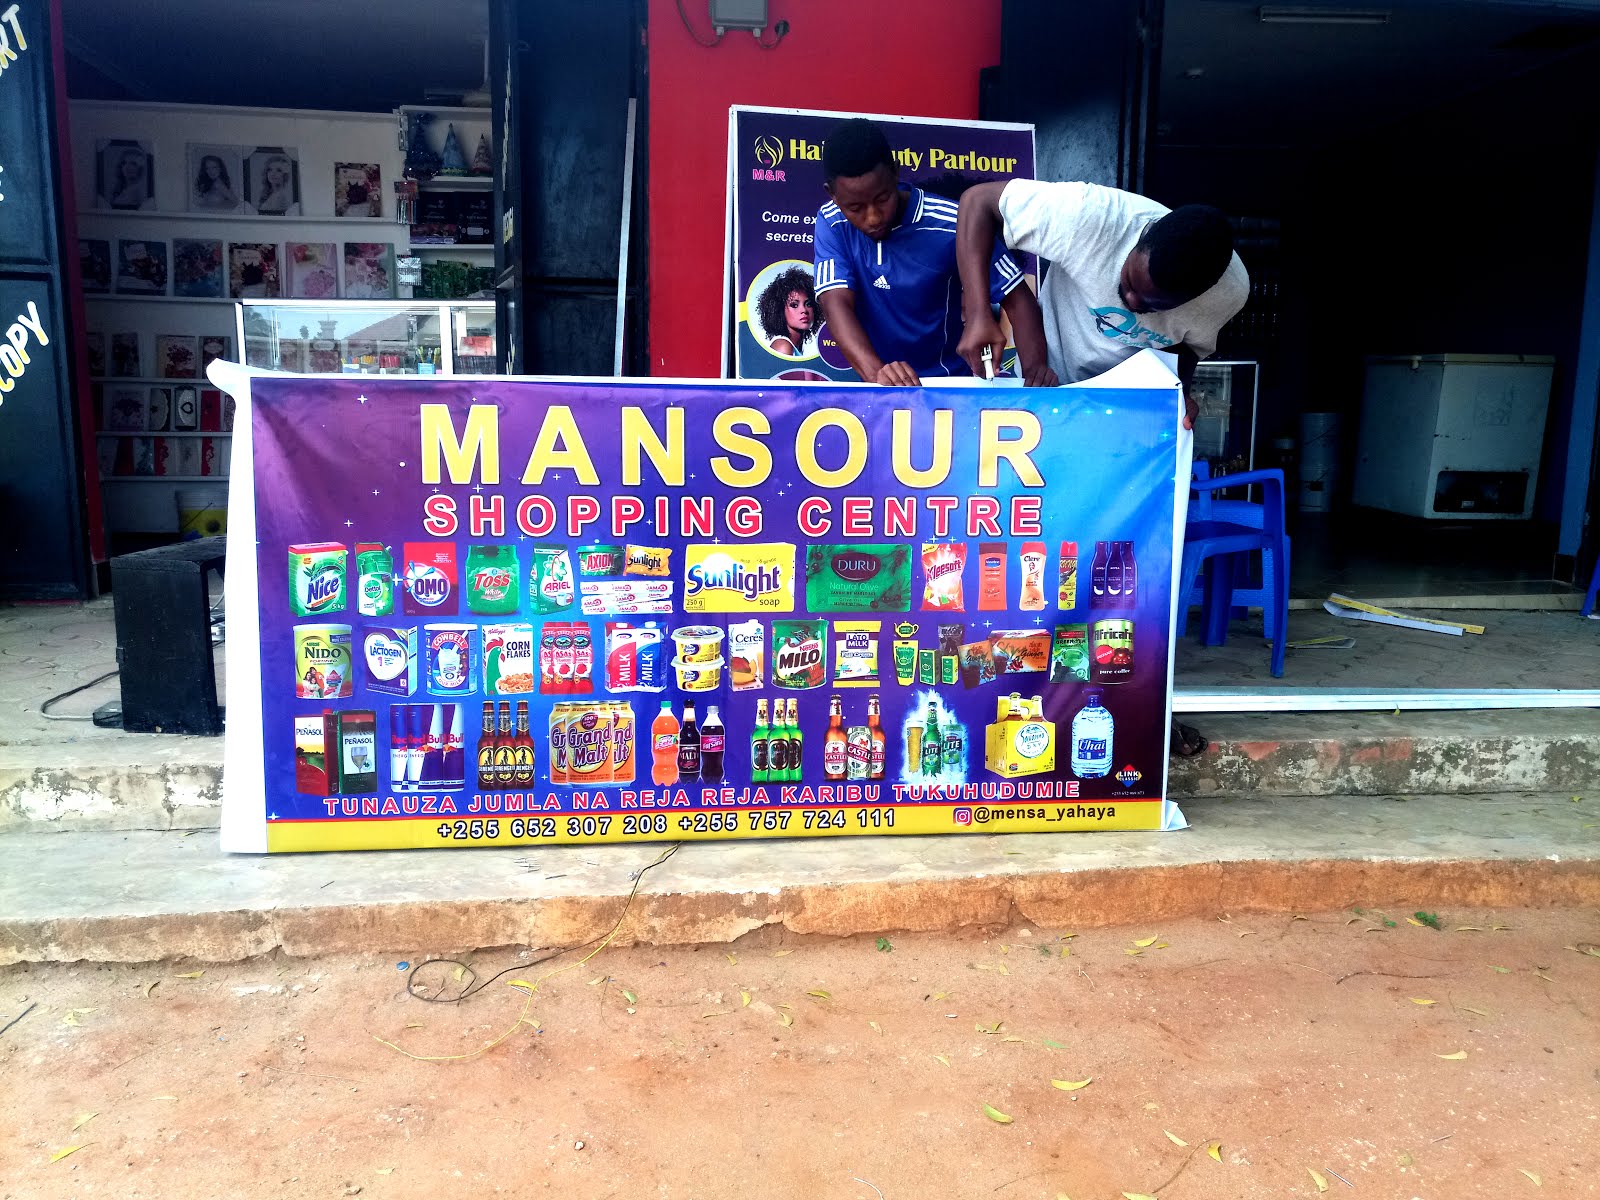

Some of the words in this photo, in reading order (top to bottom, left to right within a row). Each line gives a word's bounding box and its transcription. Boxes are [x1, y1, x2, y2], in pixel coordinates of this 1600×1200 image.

[929, 148, 1018, 173] Parlour
[753, 169, 786, 183] M&R
[761, 210, 799, 224] Come
[803, 215, 817, 225] ex
[765, 230, 814, 244] secrets
[420, 403, 1046, 488] MANSOUR
[423, 495, 763, 537] SHOPPING
[797, 496, 1042, 537] CENTRE
[627, 552, 661, 571] Sunlight
[838, 559, 877, 571] DURU
[926, 559, 962, 582] Kleesoft
[414, 578, 448, 596] OMO
[543, 581, 571, 592] ARIEL
[686, 563, 781, 600] Sunlight
[829, 582, 857, 591] Natural
[859, 582, 879, 591] Olive
[306, 575, 340, 605] Nice
[364, 585, 382, 594] Dettol
[759, 598, 780, 607] soap
[433, 633, 467, 649] COWBELL
[735, 634, 763, 643] Ceres
[848, 634, 868, 642] LATO
[304, 646, 342, 659] NIDO
[369, 645, 402, 658] LACTOGEN
[506, 640, 530, 651] CORN
[506, 650, 531, 659] FLAKES
[779, 648, 820, 670] MILO
[1020, 649, 1044, 660] Ginger
[619, 652, 631, 682] MILK
[642, 651, 654, 681] MILK
[296, 728, 324, 736] PEÑASOL
[567, 720, 612, 748] Grand
[344, 737, 373, 745] PEÑASOL
[942, 740, 960, 750] LITE
[573, 744, 608, 768] Malt
[924, 746, 938, 756] LITE
[323, 795, 458, 816] TUNAUZA
[468, 792, 561, 813] JUMLA
[572, 792, 610, 810] NA
[620, 788, 690, 809] REJA
[702, 786, 770, 806] REJA
[780, 784, 880, 804] KARIBU
[892, 781, 1081, 801] TUKUHUDUMIE
[974, 804, 1116, 822] @mensa_yahaya
[437, 820, 500, 840] +255
[510, 818, 556, 838] 652
[566, 816, 612, 836] 307
[623, 814, 668, 834] 208
[678, 812, 738, 832] +255
[749, 811, 792, 830] 757
[802, 810, 846, 828] 724
[857, 808, 896, 827] 111
